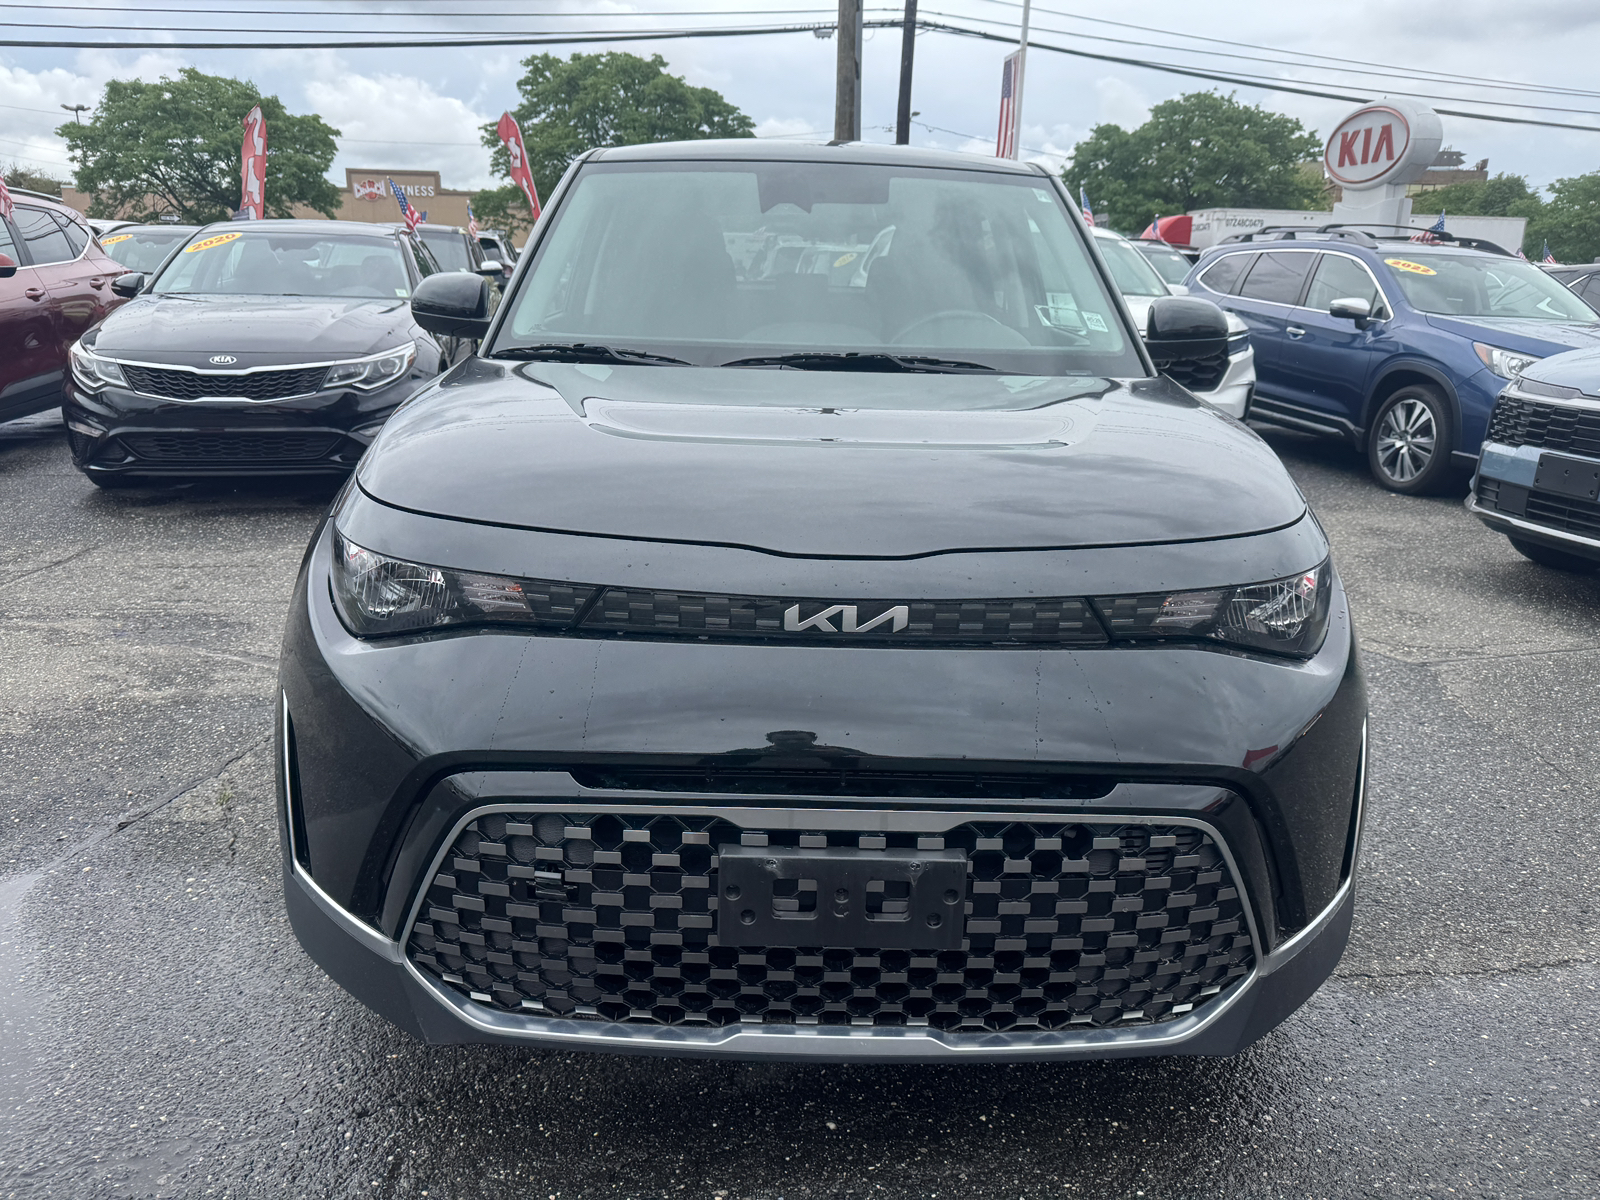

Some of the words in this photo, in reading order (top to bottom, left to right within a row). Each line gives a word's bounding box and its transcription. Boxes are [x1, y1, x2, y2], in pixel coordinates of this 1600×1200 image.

[1338, 123, 1394, 168] KIA
[192, 233, 237, 250] 2020
[1391, 261, 1431, 273] 2022
[784, 604, 909, 633] KIA
